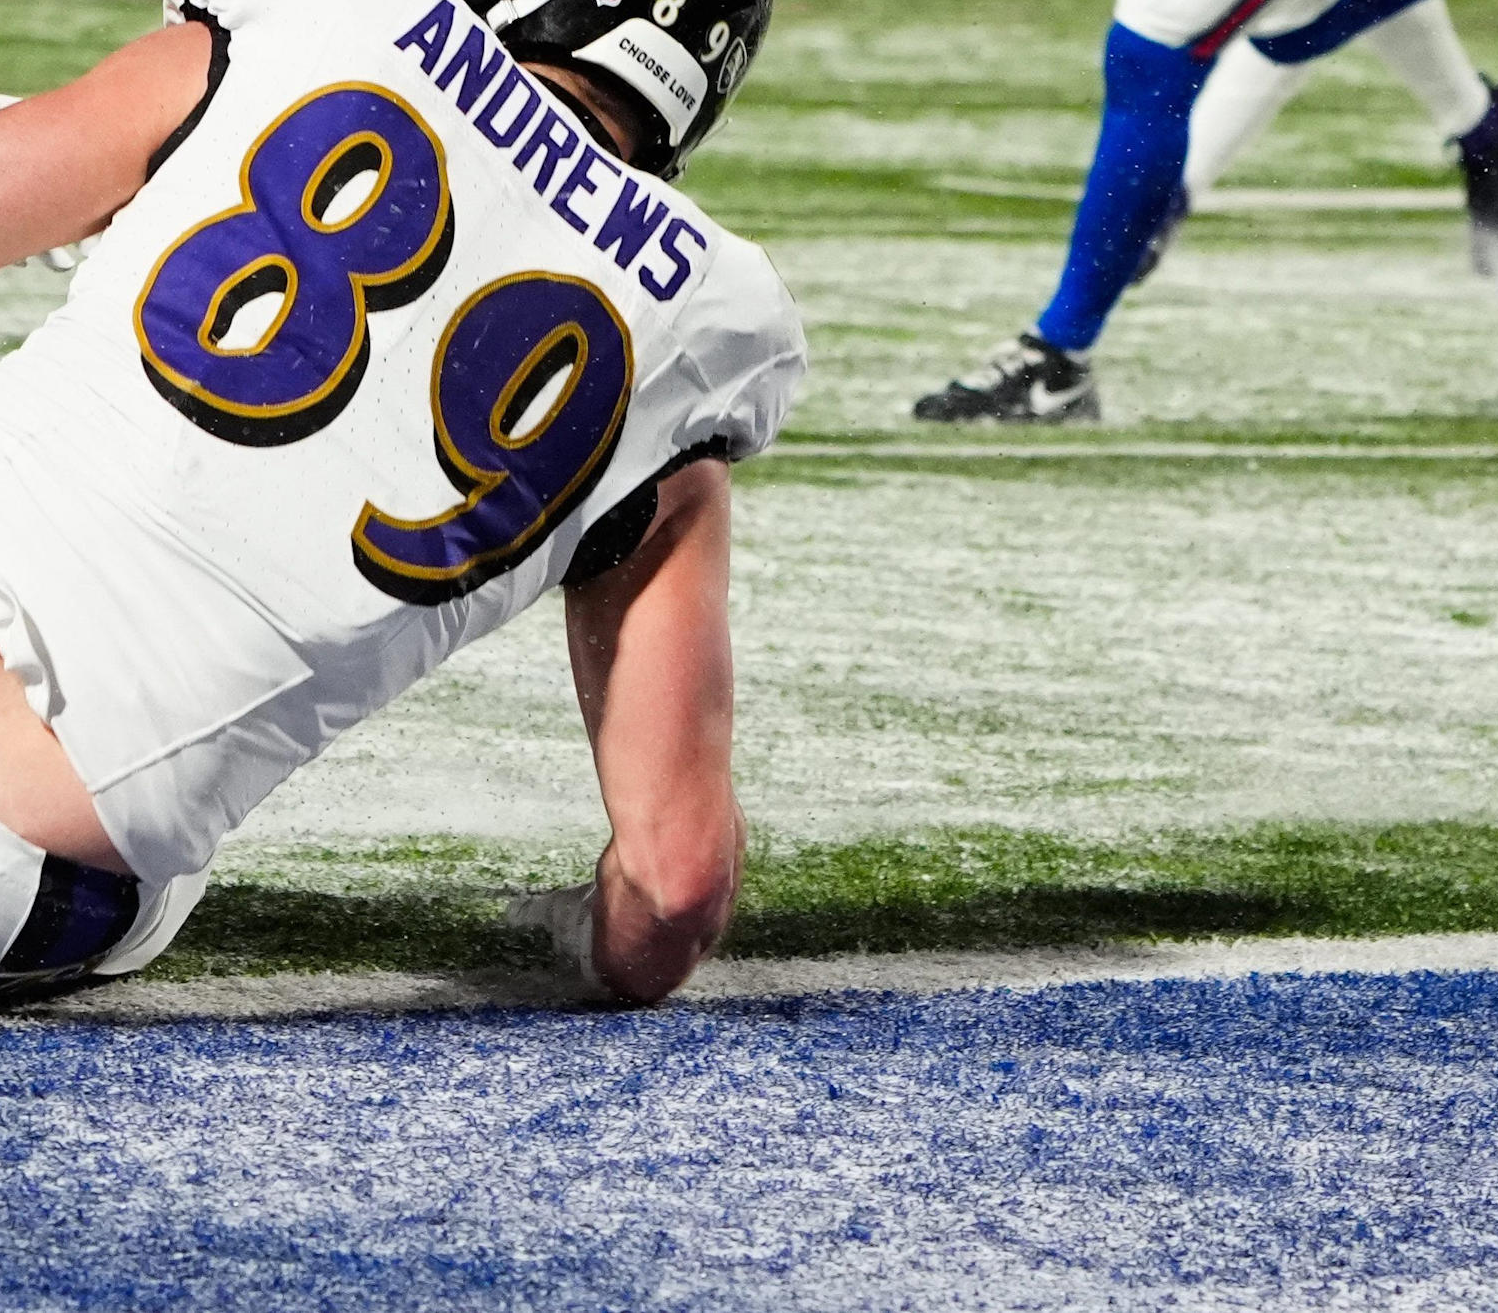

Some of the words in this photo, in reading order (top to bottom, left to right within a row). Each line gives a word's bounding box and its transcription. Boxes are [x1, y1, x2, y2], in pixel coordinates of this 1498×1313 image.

[618, 37, 671, 84] CHOOSE
[668, 78, 697, 112] LOVE
[132, 80, 637, 607] 89
